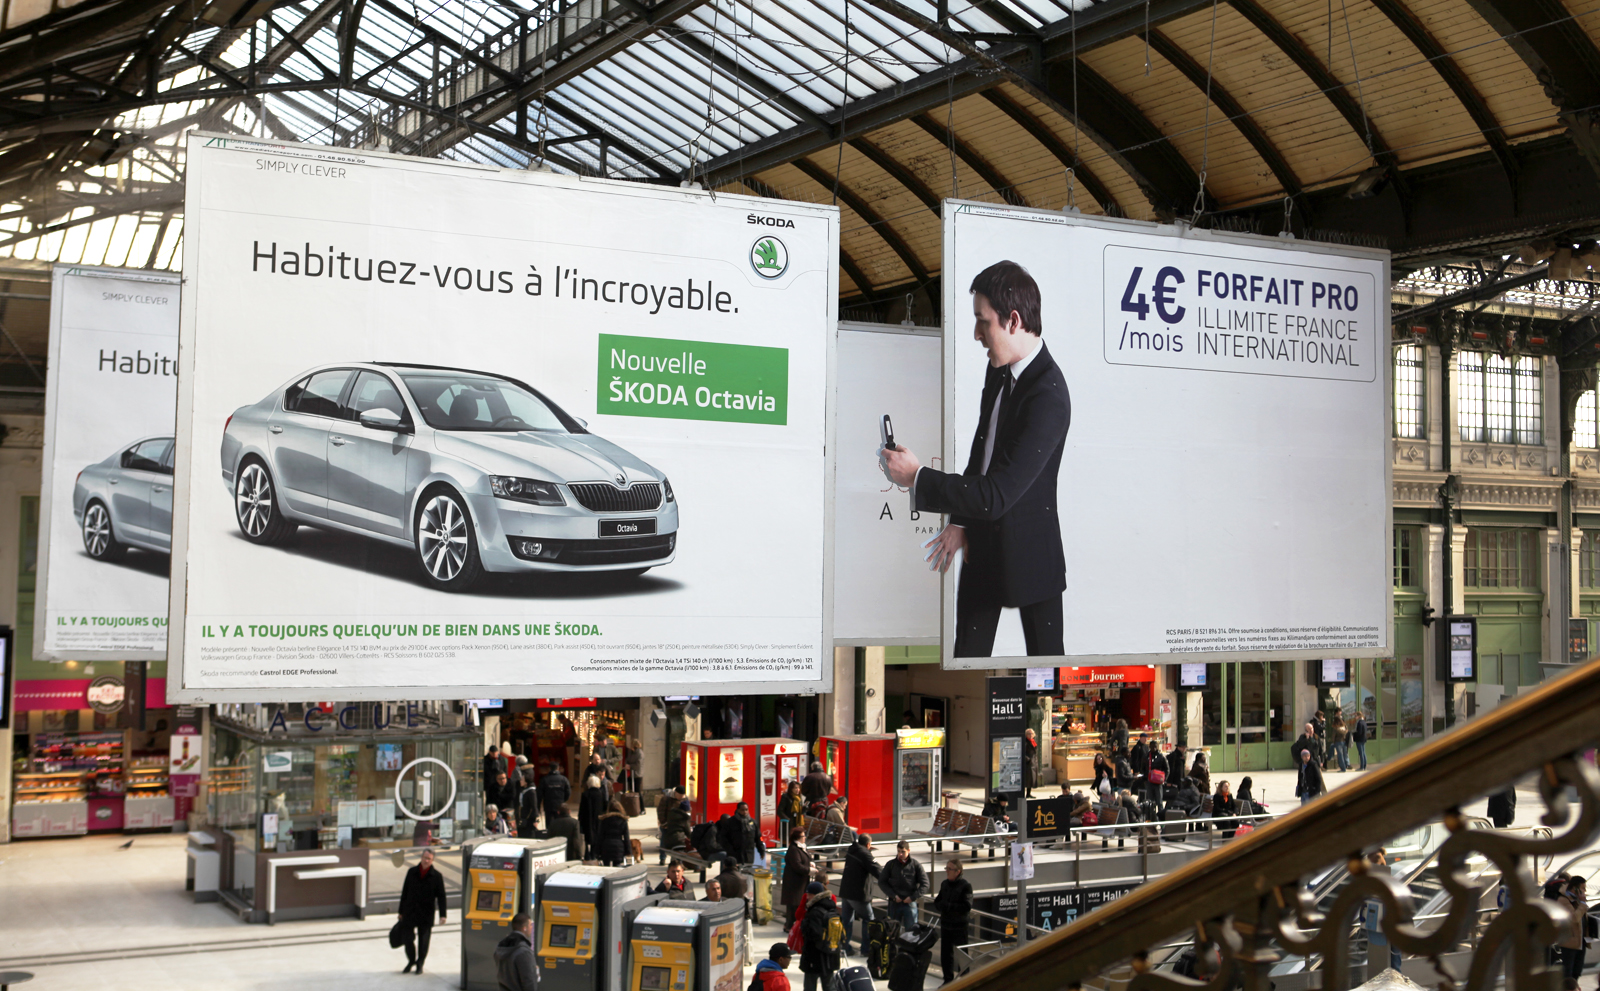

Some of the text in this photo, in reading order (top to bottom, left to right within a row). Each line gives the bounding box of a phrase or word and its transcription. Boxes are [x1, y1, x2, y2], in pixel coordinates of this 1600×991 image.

[256, 158, 346, 178] SIMPLY CLEVER
[747, 213, 795, 229] ŠKODA
[252, 240, 739, 315] Habituez-vous à l'incroyable.
[102, 292, 168, 305] SIMPLY CLEVER
[1120, 265, 1186, 324] 4€
[1198, 269, 1358, 312] FORFAIT PRO
[1198, 306, 1358, 341] ILLIMITE FRANCE
[1119, 321, 1184, 352] /mois
[1198, 332, 1360, 367] INTERNATIONAL
[610, 348, 706, 376] Nouvelle
[609, 376, 776, 412] ŠKODA Octavia
[617, 524, 638, 533] Octavia
[57, 616, 68, 626] IL
[70, 616, 78, 626] Y
[80, 616, 88, 626] A
[91, 616, 149, 628] TOUJOURS
[202, 622, 603, 640] IL Y A TOUJOURS QUELQU'UN DE BIEN DANS UNE ŠKODA.
[992, 703, 1022, 714] Hall 1
[1053, 896, 1072, 906] Hall
[1075, 894, 1080, 904] 1
[1042, 918, 1052, 931] A
